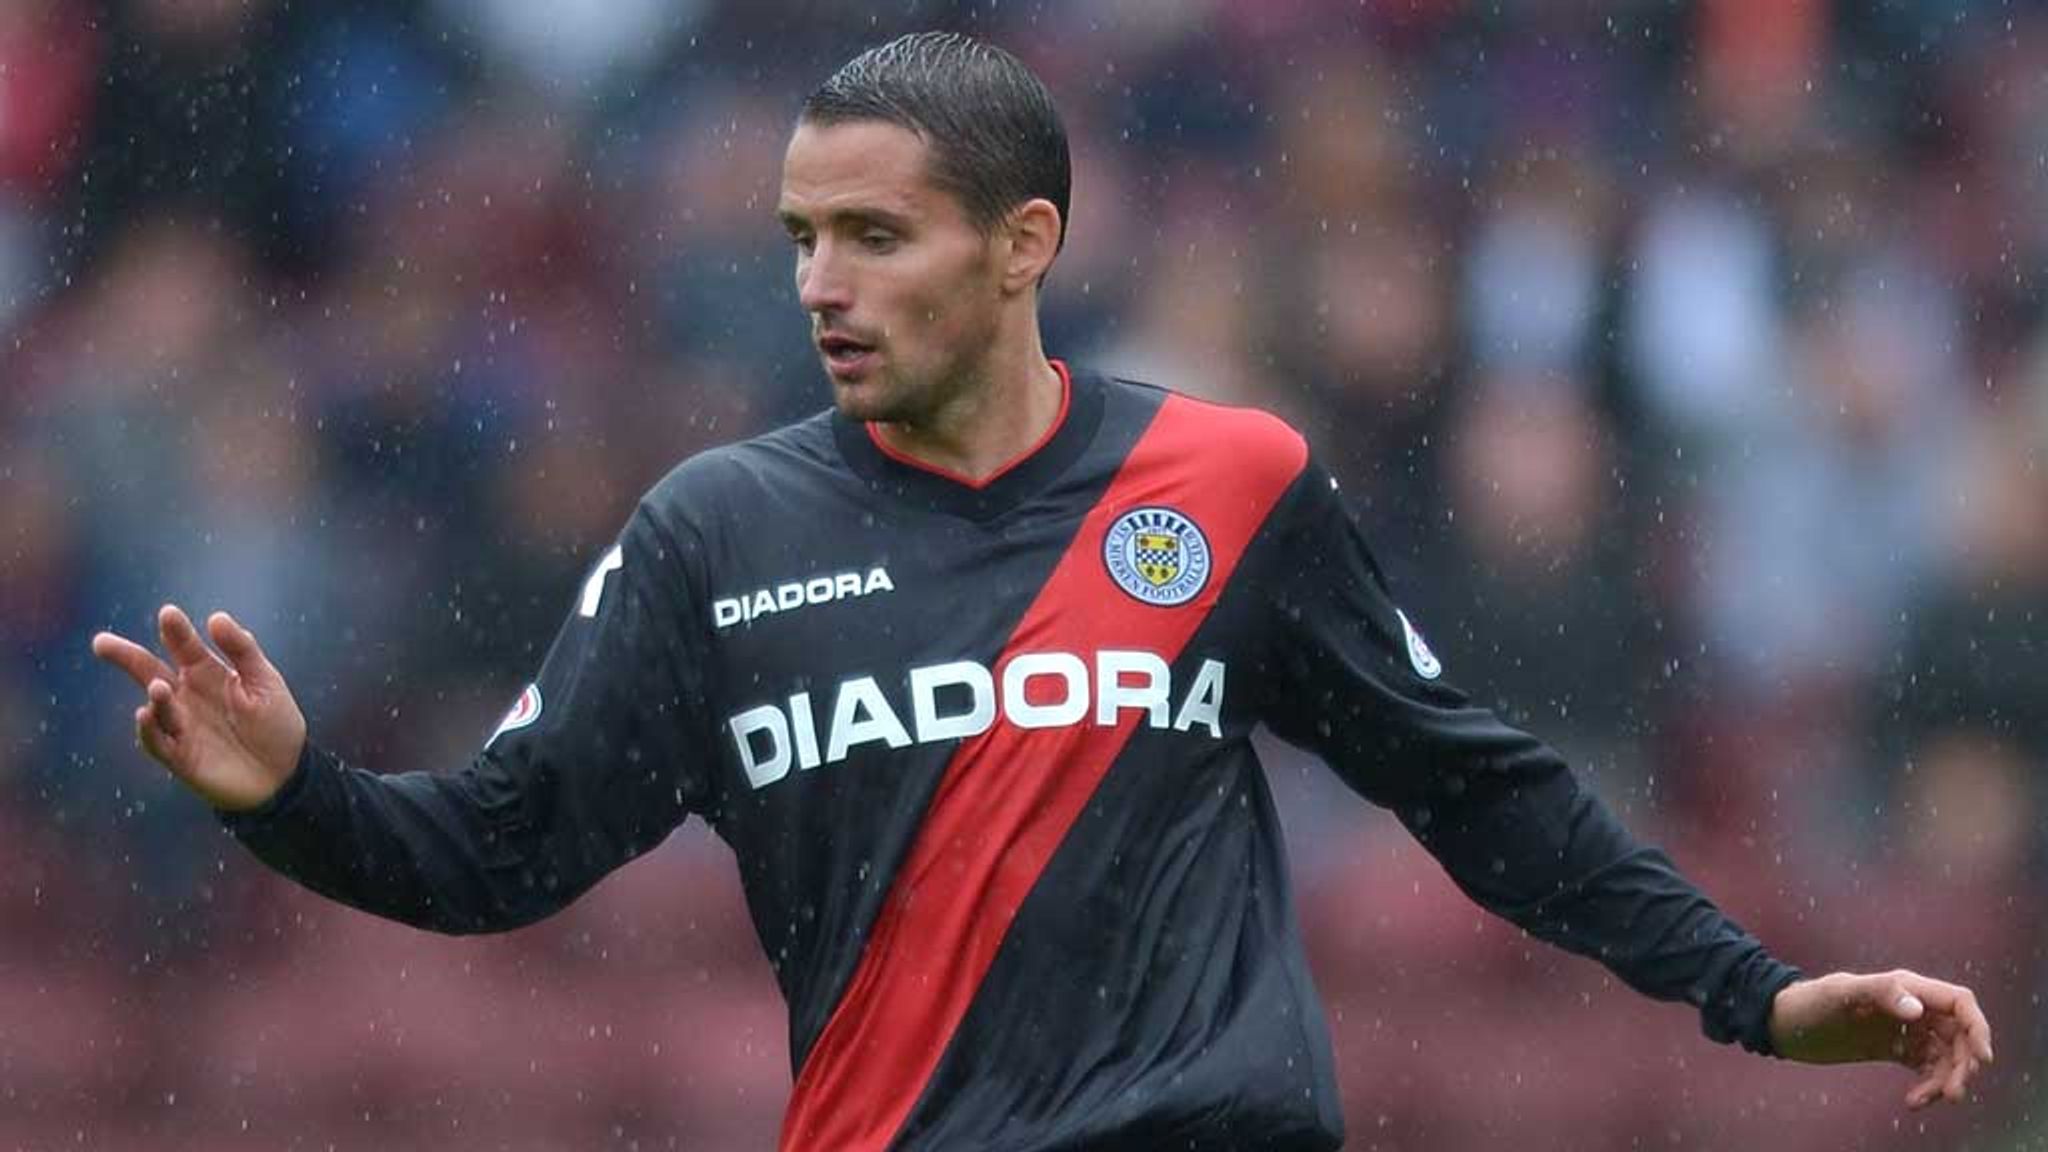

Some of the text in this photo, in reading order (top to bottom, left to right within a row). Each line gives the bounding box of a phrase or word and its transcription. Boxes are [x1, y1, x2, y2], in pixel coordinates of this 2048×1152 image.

[713, 566, 895, 629] DIADORA
[1109, 543, 1141, 591] MIRREN
[1142, 567, 1203, 598] FOOTBALL
[729, 648, 1226, 790] DIADORA
